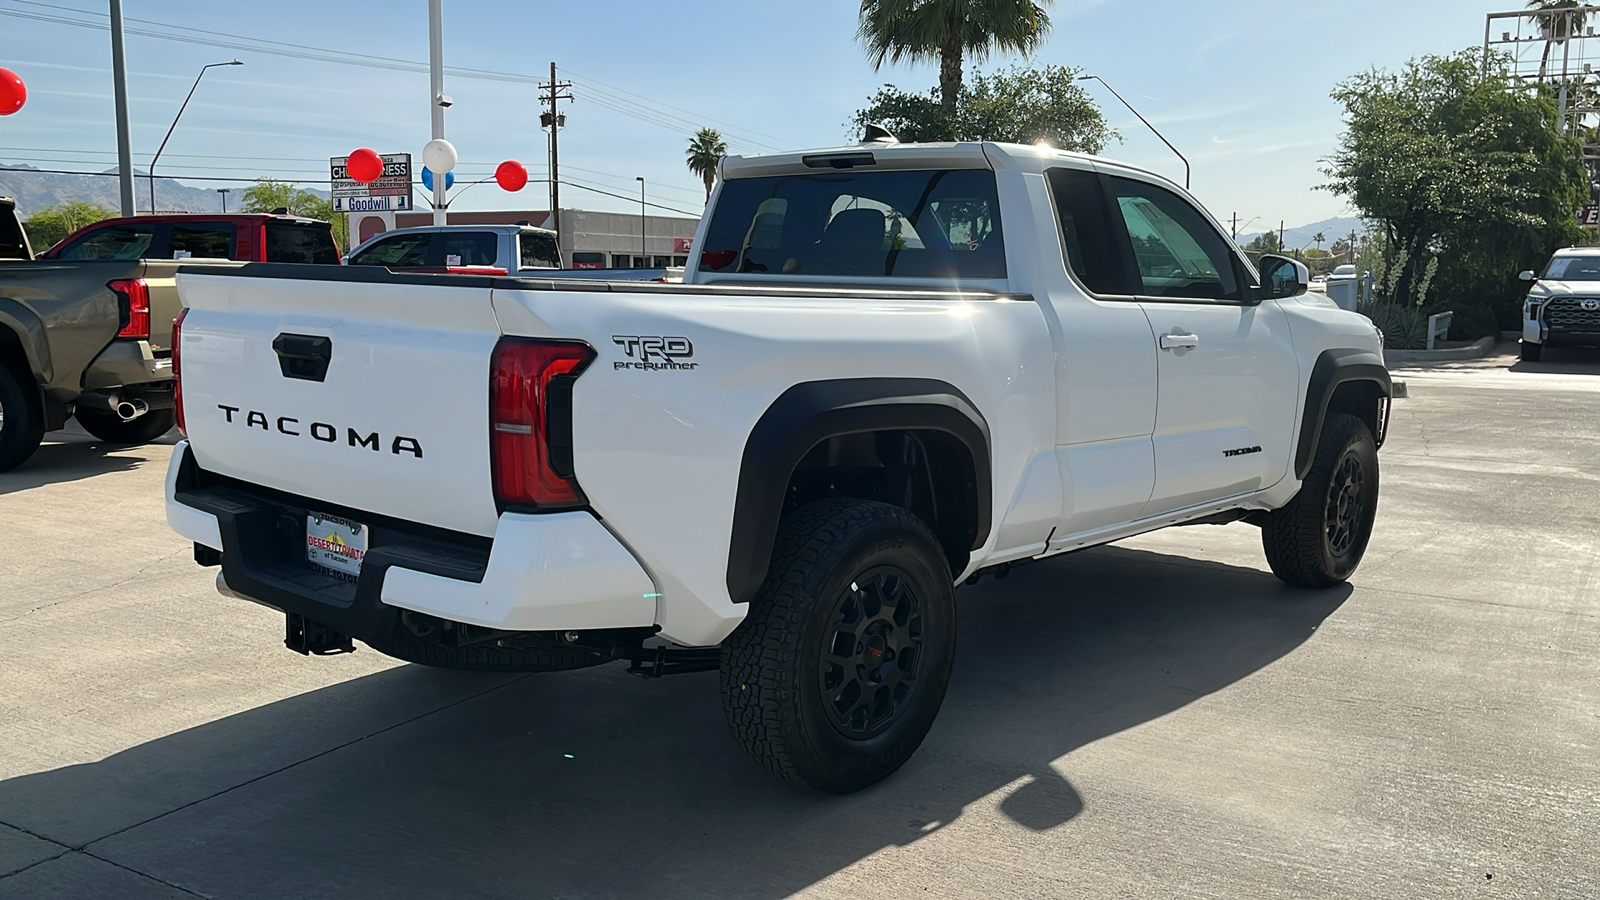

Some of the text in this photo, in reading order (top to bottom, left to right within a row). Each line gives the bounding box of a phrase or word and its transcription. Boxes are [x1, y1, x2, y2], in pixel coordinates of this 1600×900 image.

[349, 196, 390, 210] Goodwill
[612, 335, 694, 363] TRD
[217, 404, 423, 459] TACOMA
[1222, 445, 1263, 458] TACOMA
[320, 513, 351, 527] TUCSON
[308, 535, 364, 560] DESERT TOYOTA
[330, 553, 349, 565] Tucson
[332, 569, 358, 584] TOYOT
